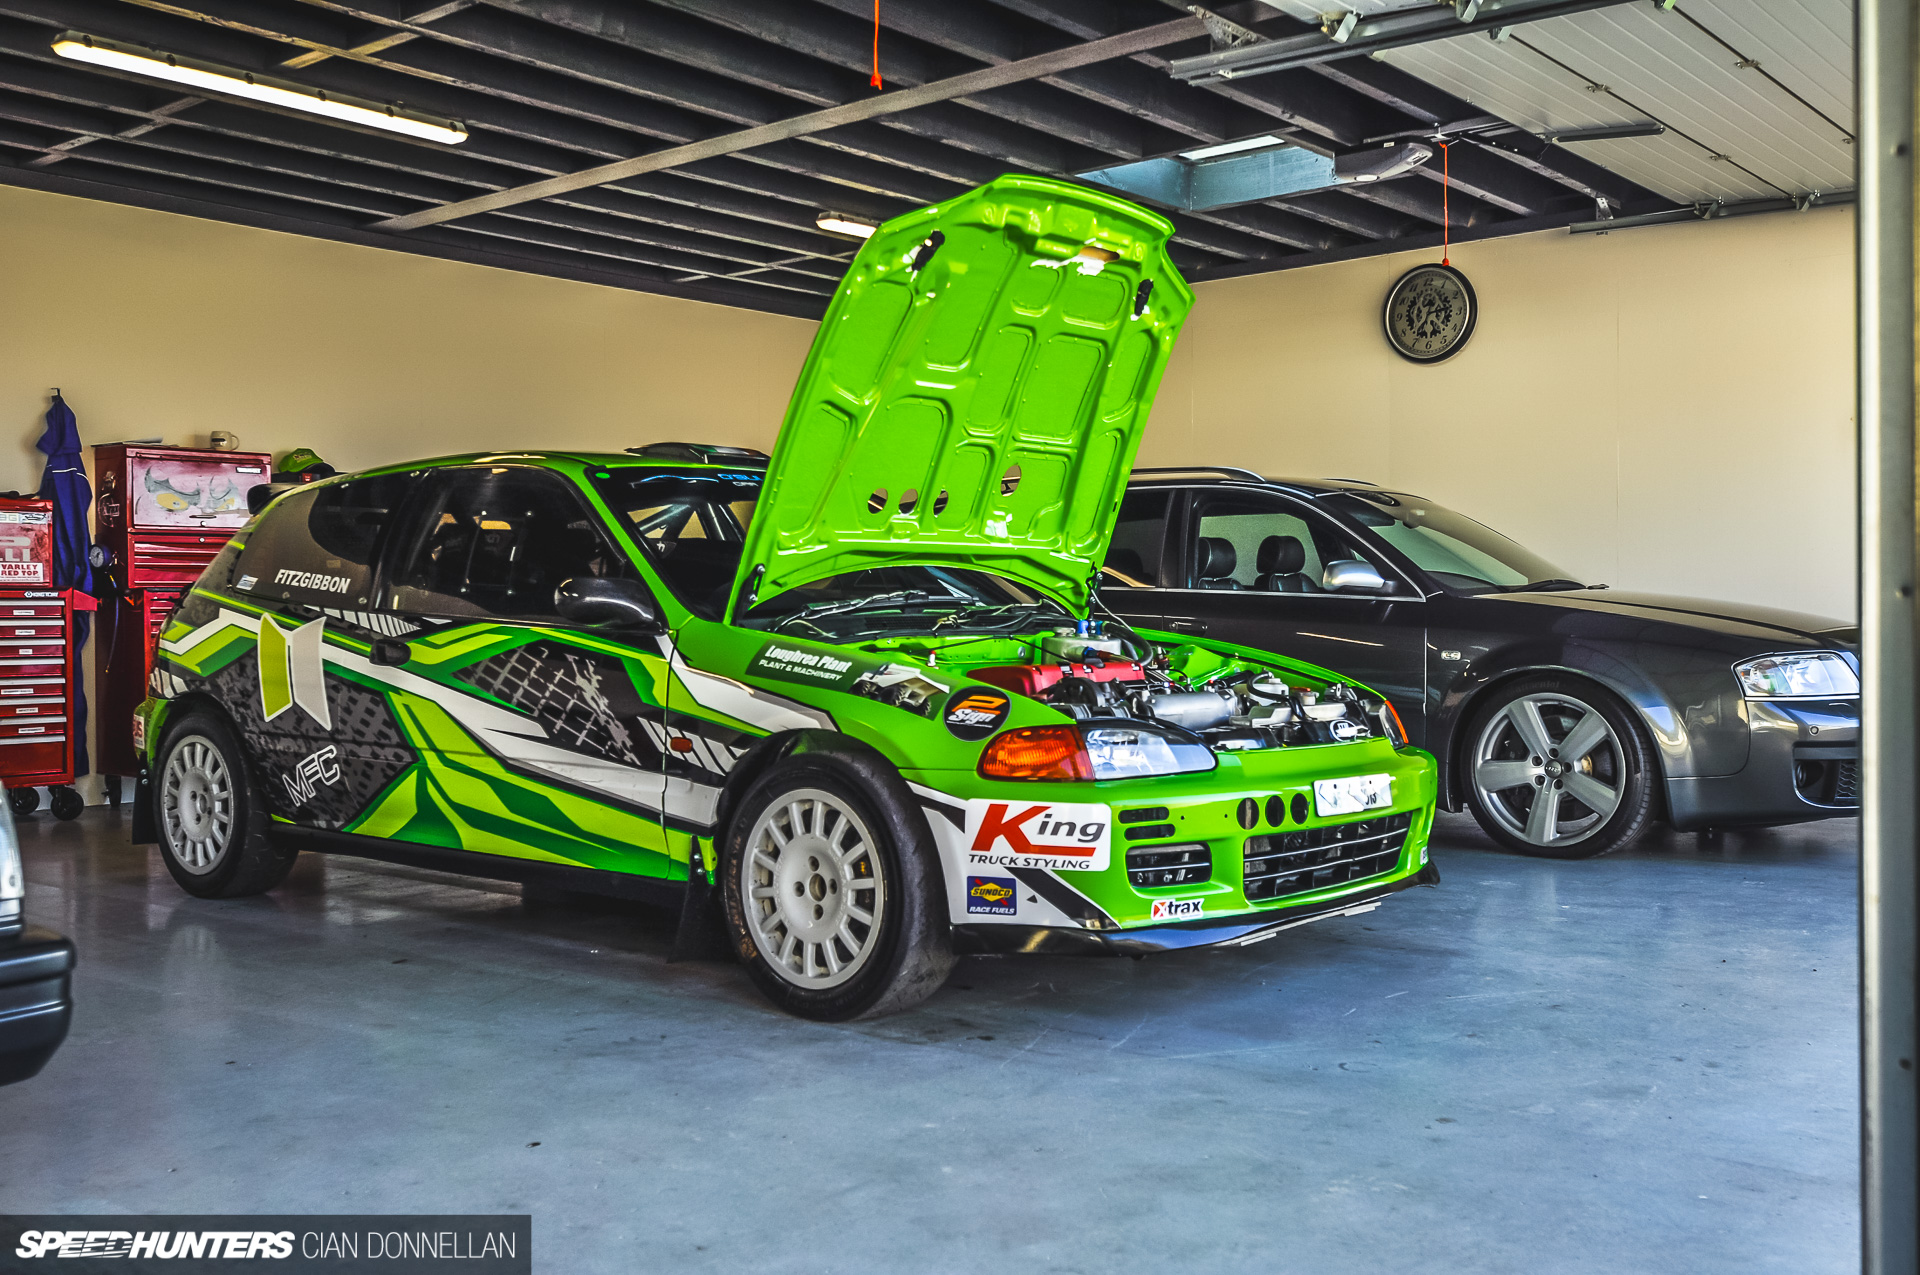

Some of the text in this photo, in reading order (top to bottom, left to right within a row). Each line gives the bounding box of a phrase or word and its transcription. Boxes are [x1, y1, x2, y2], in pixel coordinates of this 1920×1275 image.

[1423, 278, 1433, 286] 12
[1441, 280, 1446, 289] 1
[1409, 283, 1418, 292] 11
[1452, 291, 1458, 299] 2
[1398, 296, 1409, 305] 10
[1456, 307, 1462, 316] 3
[1396, 313, 1402, 322] 9
[1452, 323, 1458, 332] 4
[1401, 329, 1407, 337] 8
[1412, 338, 1419, 348] 7
[1440, 335, 1447, 344] 5
[1425, 341, 1432, 349] 6
[274, 569, 351, 593] FITZGIBBON
[765, 645, 853, 673] Loughrea Plant
[759, 659, 786, 670] PLANT
[792, 665, 843, 681] MACHINERY
[952, 695, 1007, 715] 2
[948, 708, 997, 724] Sign
[282, 745, 340, 807] MFC
[971, 803, 1106, 857] King
[969, 854, 1090, 870] TRUCK STYLING
[972, 888, 1011, 897] SUNOCO
[969, 906, 990, 914] RACE
